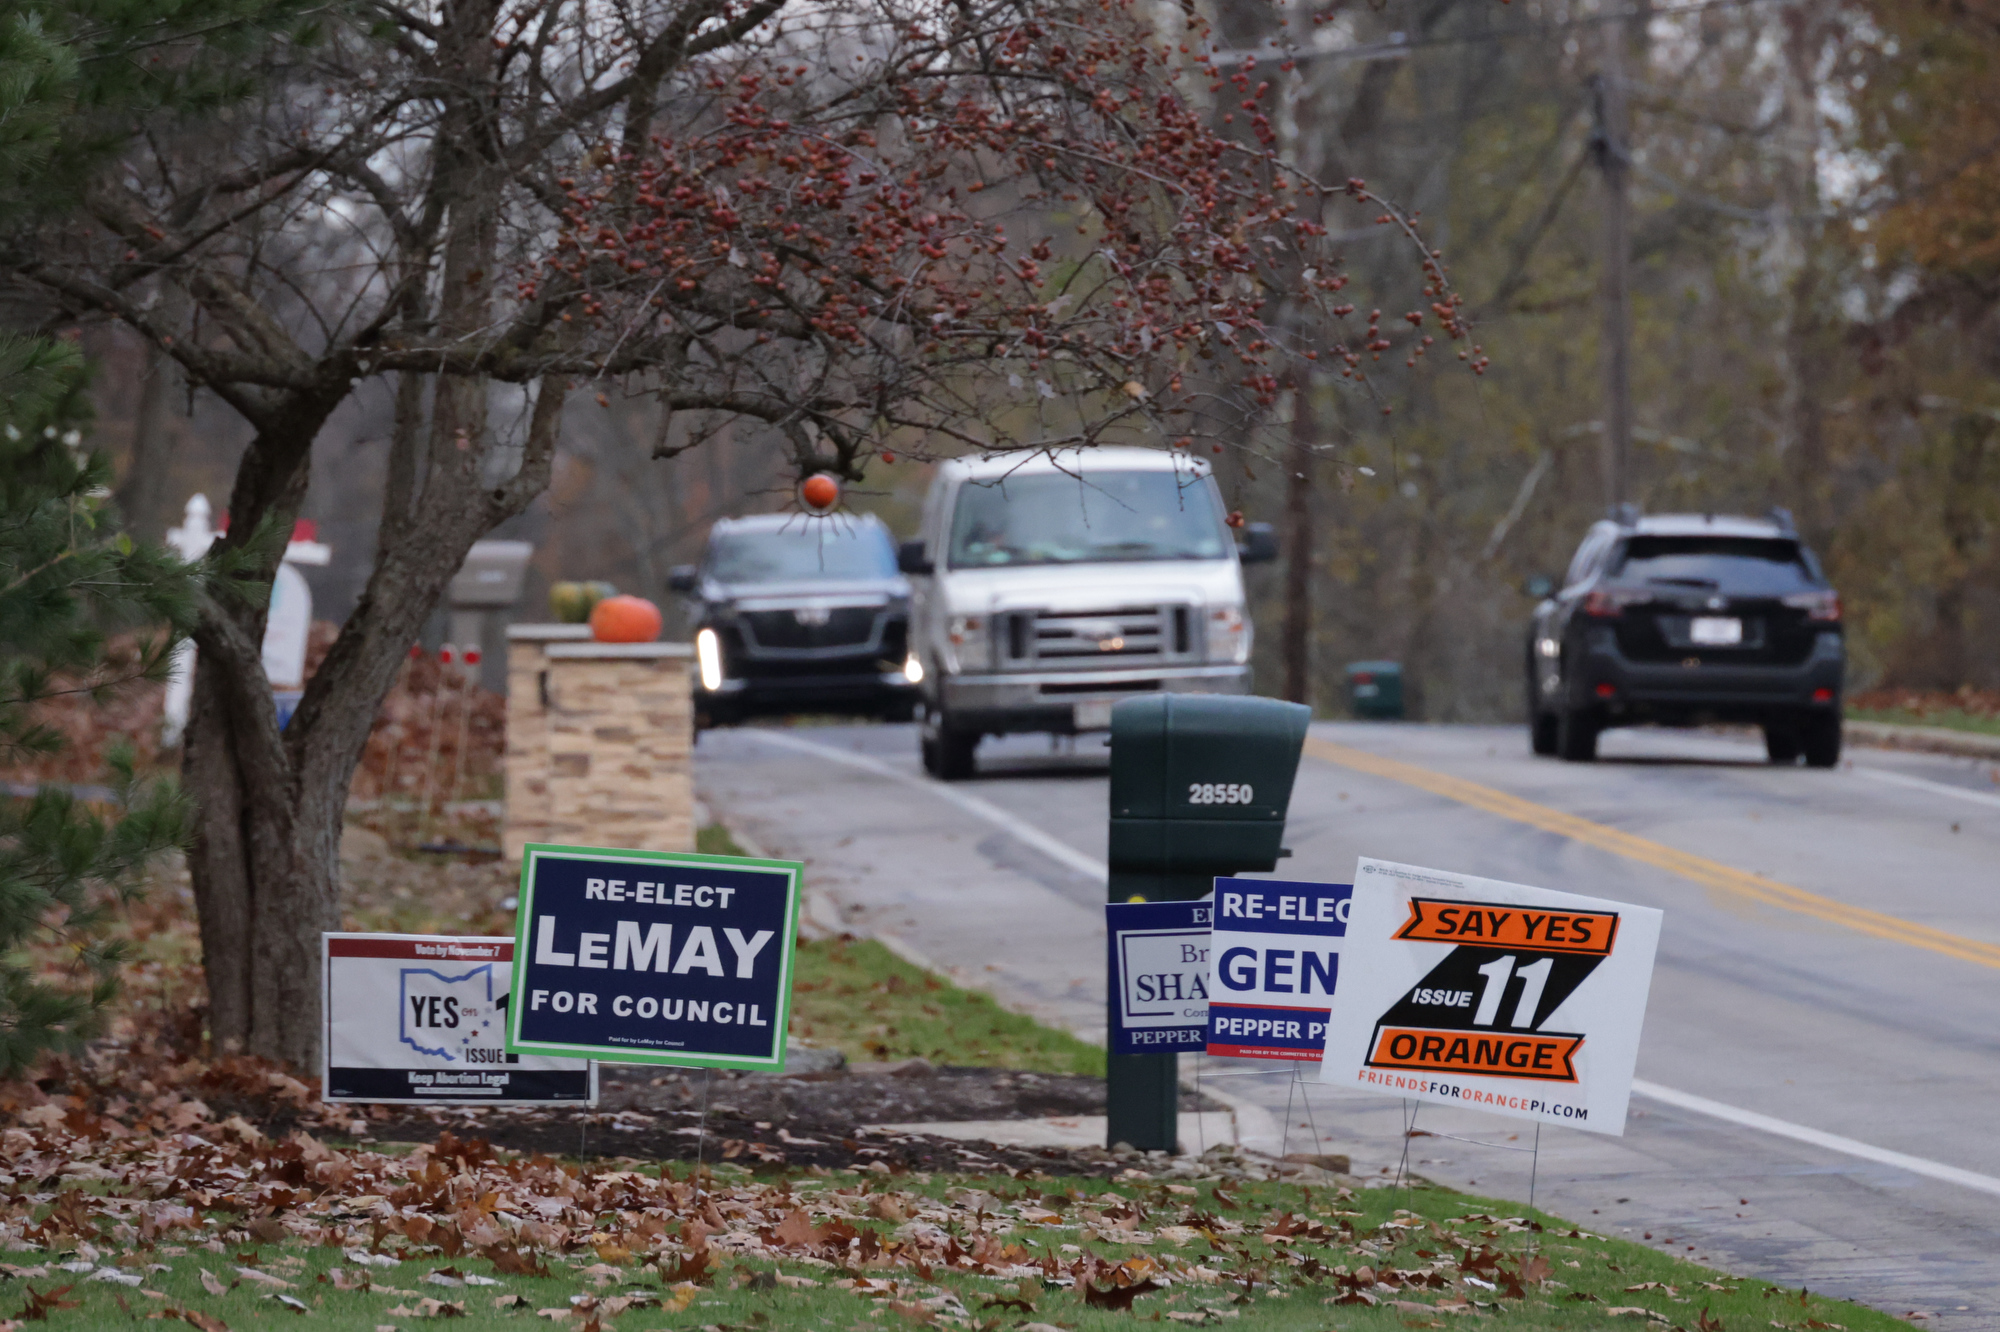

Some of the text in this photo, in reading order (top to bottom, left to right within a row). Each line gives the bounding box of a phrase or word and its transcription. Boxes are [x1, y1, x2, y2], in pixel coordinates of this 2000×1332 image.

[1189, 783, 1253, 805] 28550
[585, 878, 736, 909] RE-ELECT
[1222, 892, 1351, 923] RE-ELEC
[1434, 908, 1594, 943] SAY YES
[415, 943, 500, 957] Vote by November 7
[1218, 946, 1339, 996] GEN
[1136, 972, 1210, 1002] SHA
[1411, 954, 1554, 1029] ISSUE 11
[410, 995, 478, 1028] YES on
[531, 989, 767, 1026] FOR COUNCIL
[1131, 1030, 1202, 1045] PEPPER
[1215, 1017, 1301, 1039] PEPPER
[466, 1048, 503, 1063] ISSUE
[1389, 1033, 1557, 1069] ORANGE
[408, 1071, 510, 1087] Keep Abortion Legal
[1358, 1070, 1588, 1120] FRIENDSFORORANGEPI.COM
